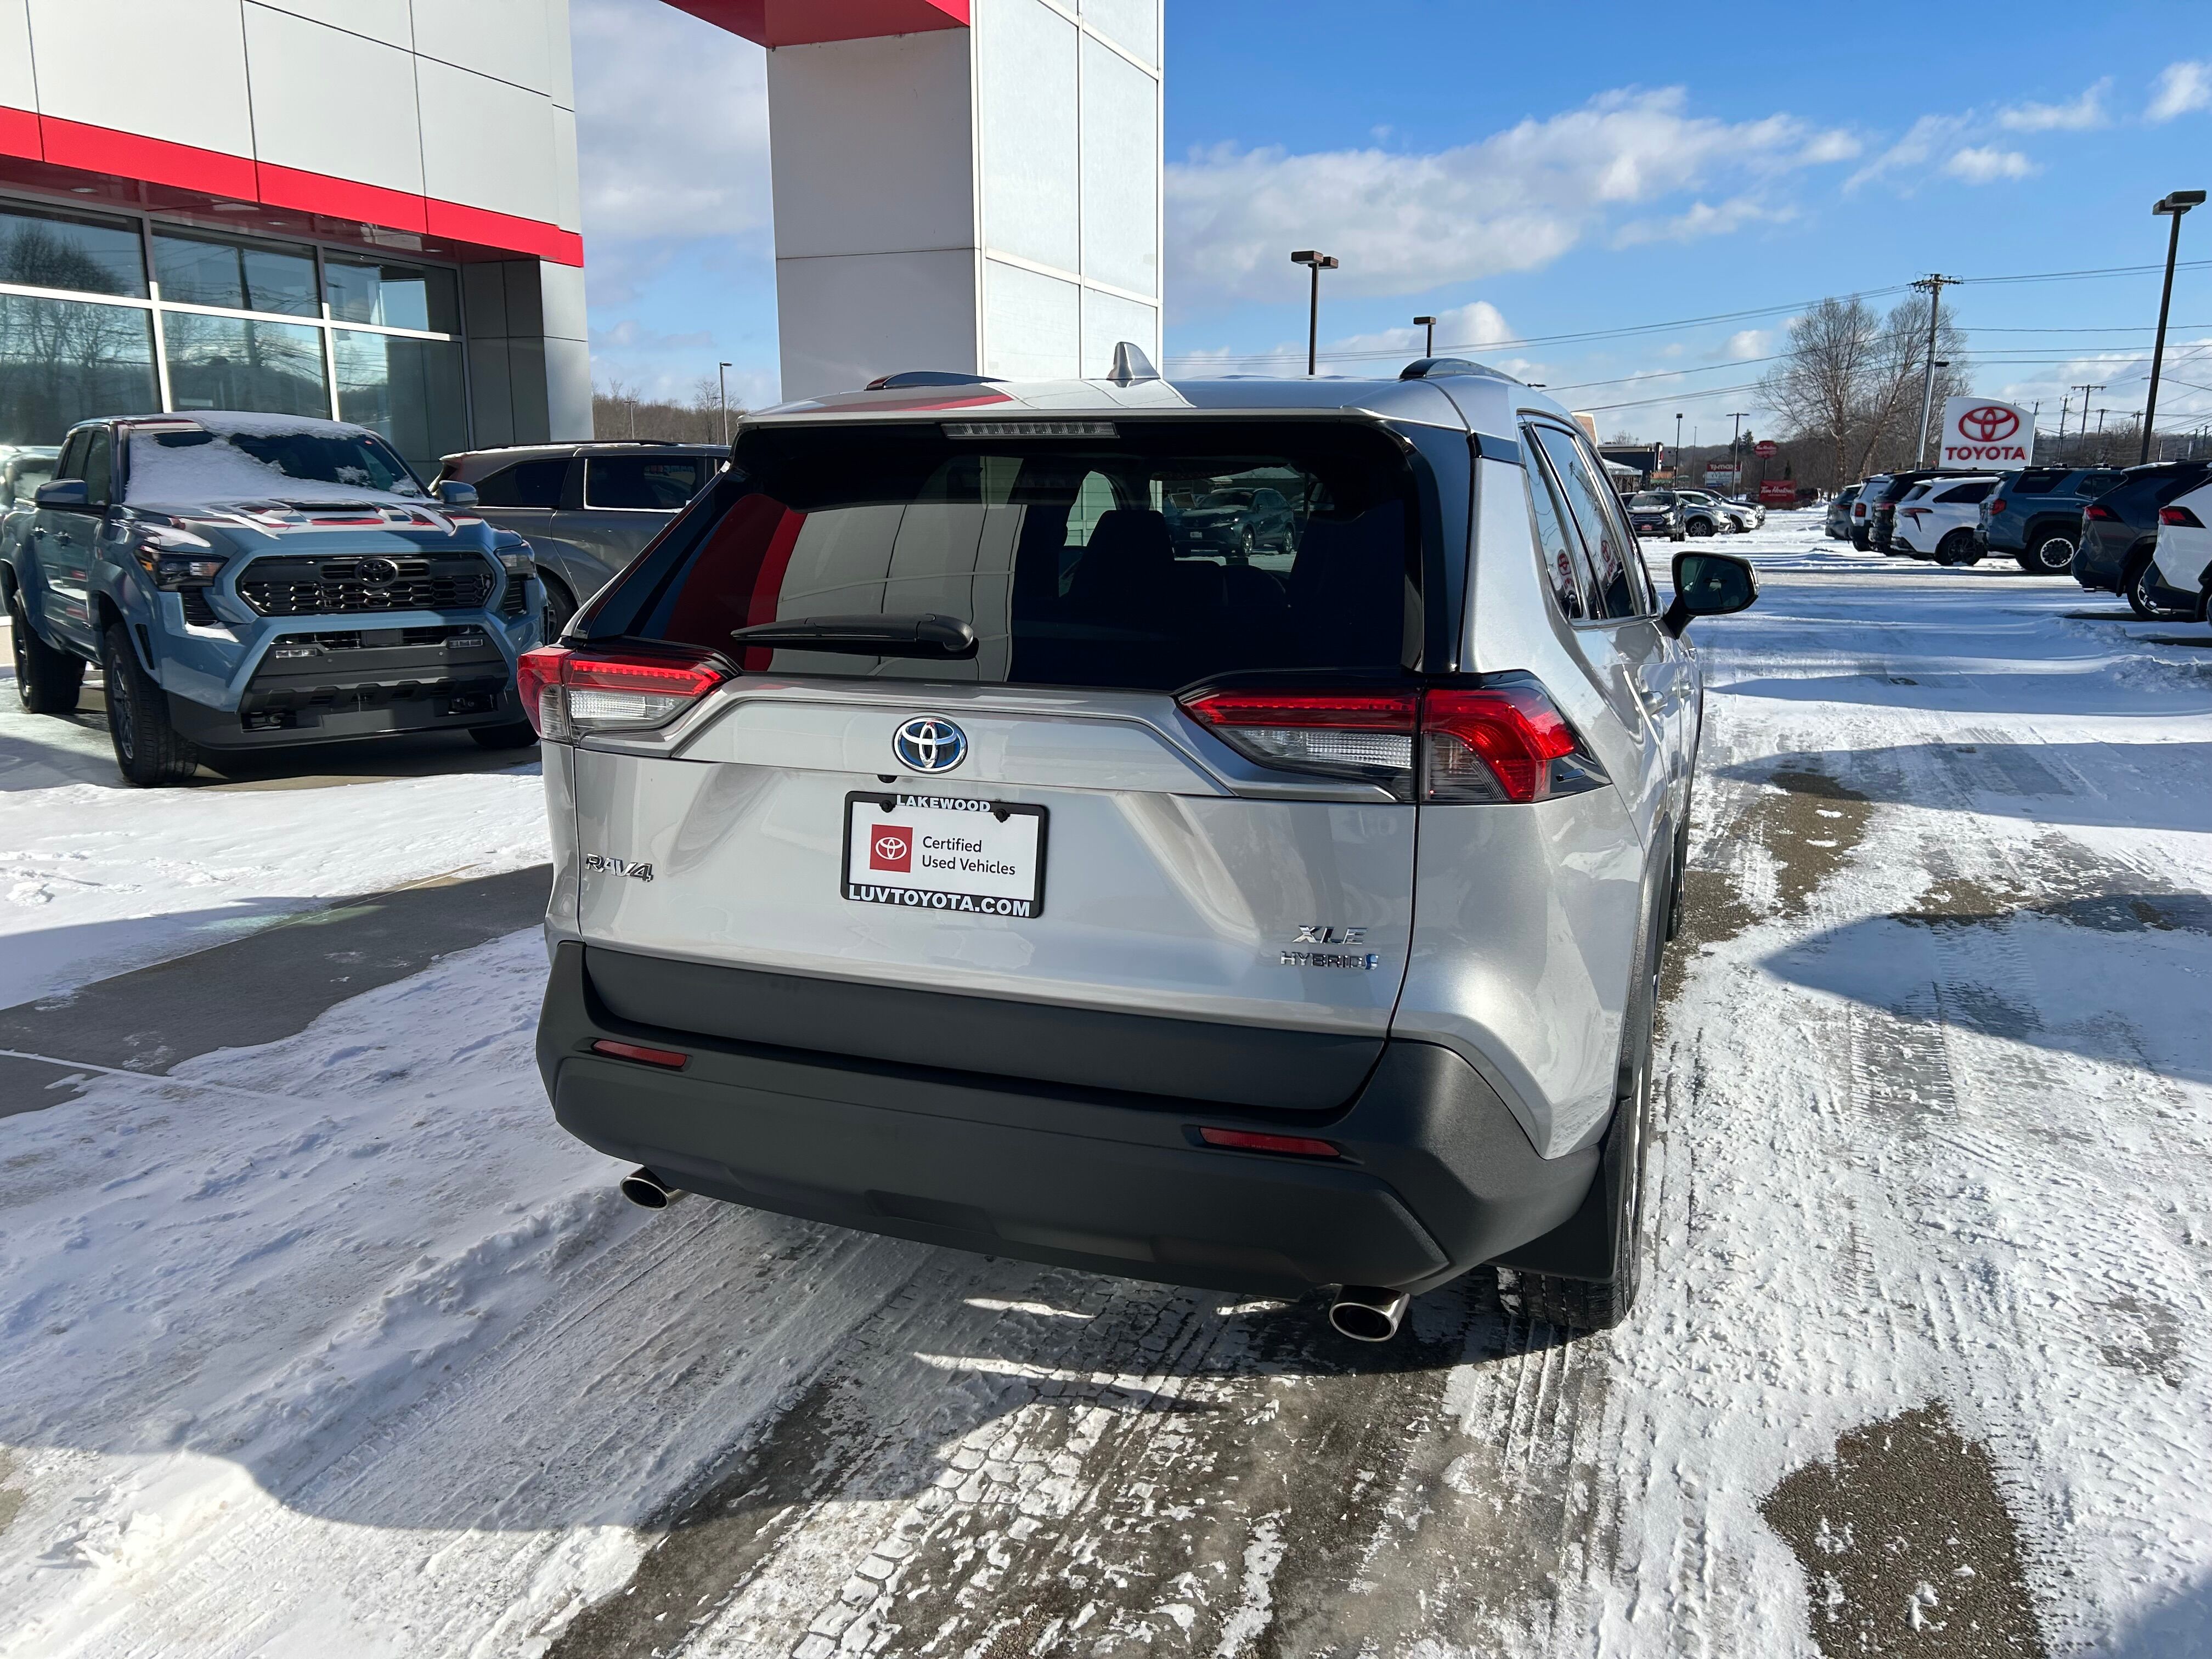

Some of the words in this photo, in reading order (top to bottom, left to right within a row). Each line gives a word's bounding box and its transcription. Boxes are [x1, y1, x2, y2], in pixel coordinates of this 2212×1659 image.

[1945, 446, 2026, 460] TOYOTA
[896, 794, 991, 812] LAKEWOOD
[922, 836, 983, 853] Certified
[585, 853, 654, 883] RAV4
[922, 855, 956, 871] Used
[960, 858, 1016, 876] Vehicles
[849, 884, 1030, 918] LUVTOYOTA.COM
[1291, 924, 1368, 945] XLE
[1280, 951, 1366, 969] HYBRID
